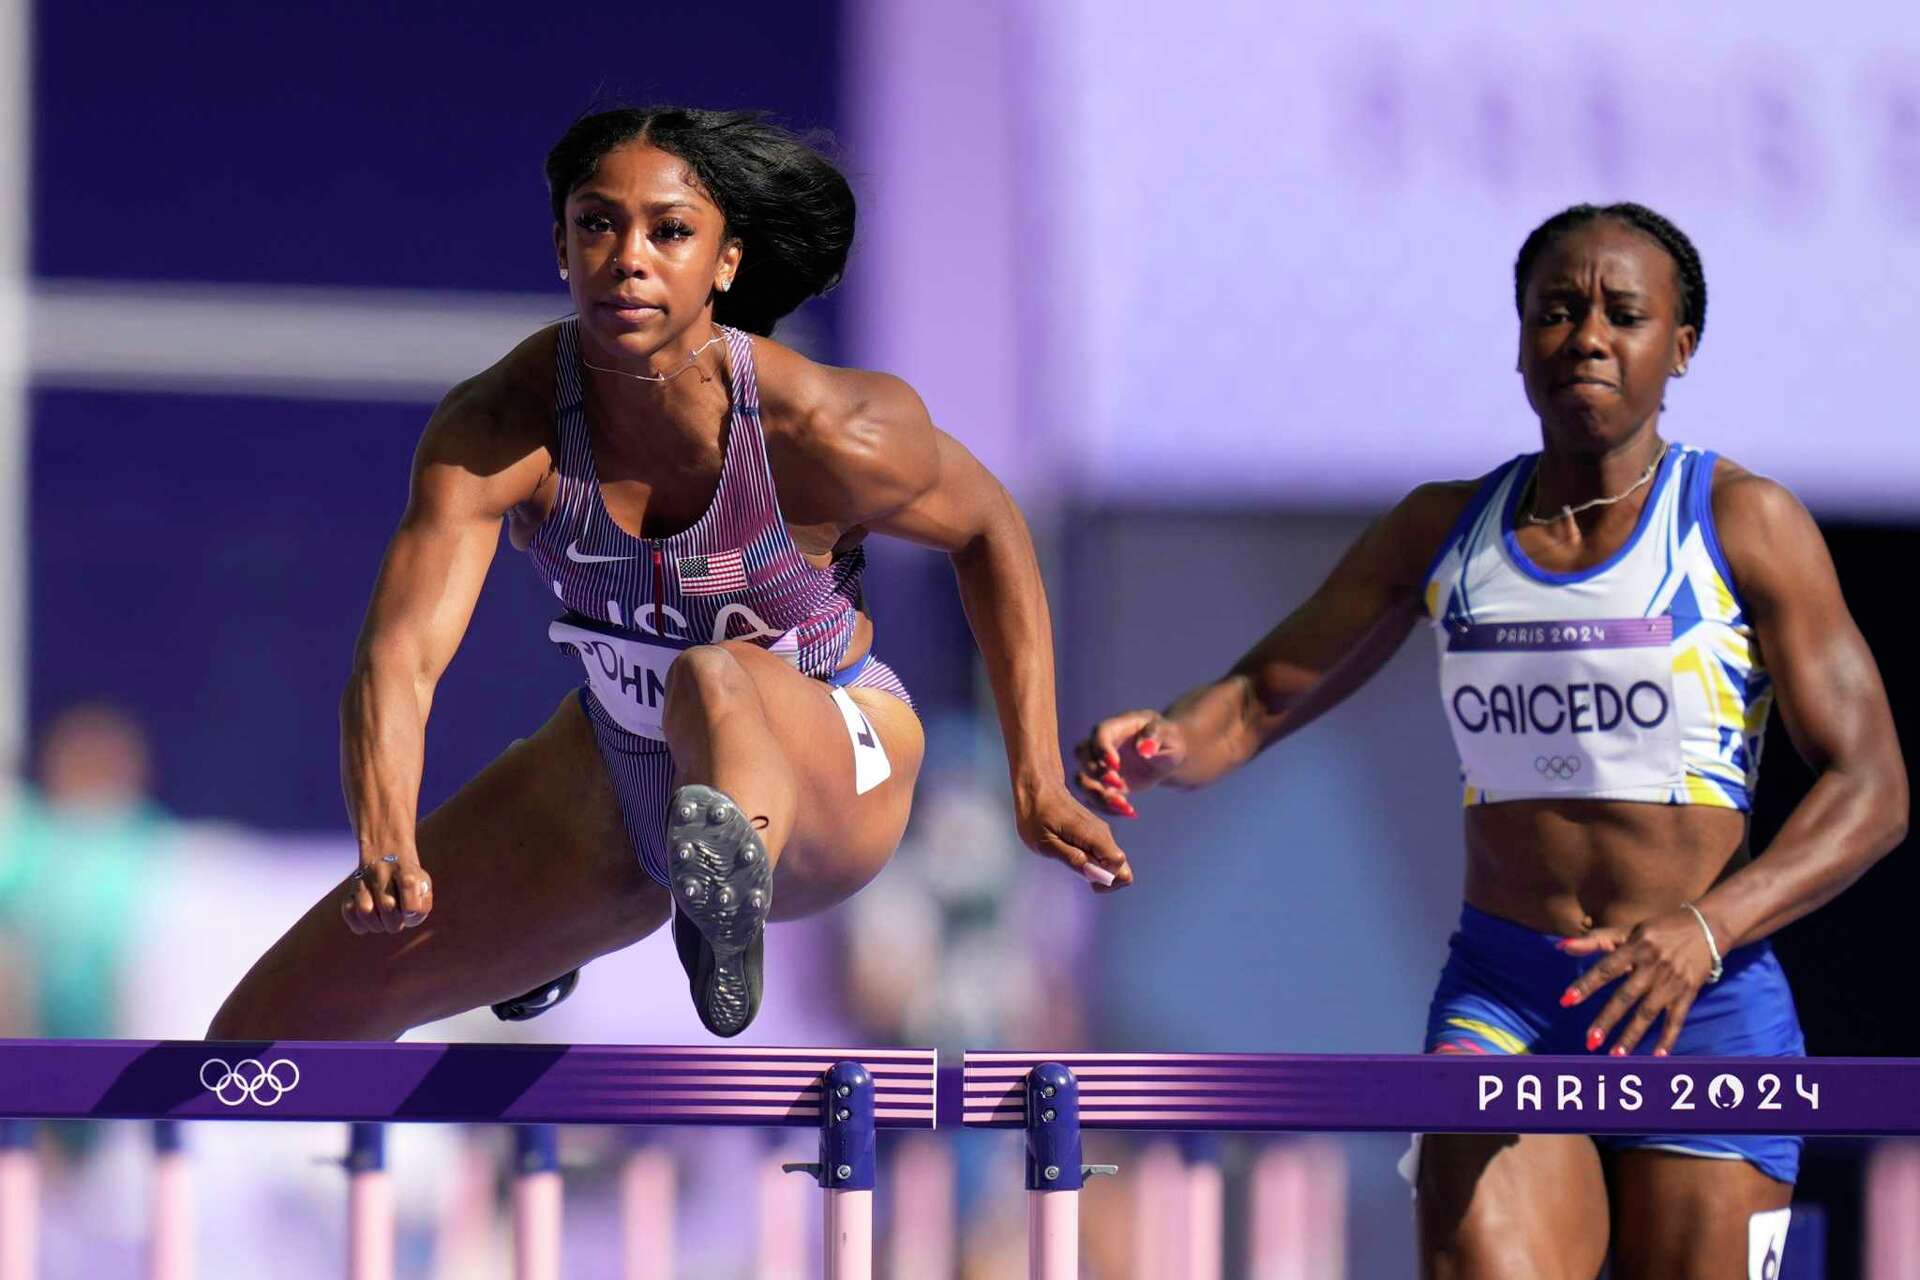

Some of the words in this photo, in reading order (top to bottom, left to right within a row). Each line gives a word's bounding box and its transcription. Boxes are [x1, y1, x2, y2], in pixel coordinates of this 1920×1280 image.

[1496, 626, 1545, 643] PARIS
[1550, 625, 1605, 642] 2024
[1453, 680, 1669, 735] CAICEDO
[1670, 1073, 1820, 1110] 2024
